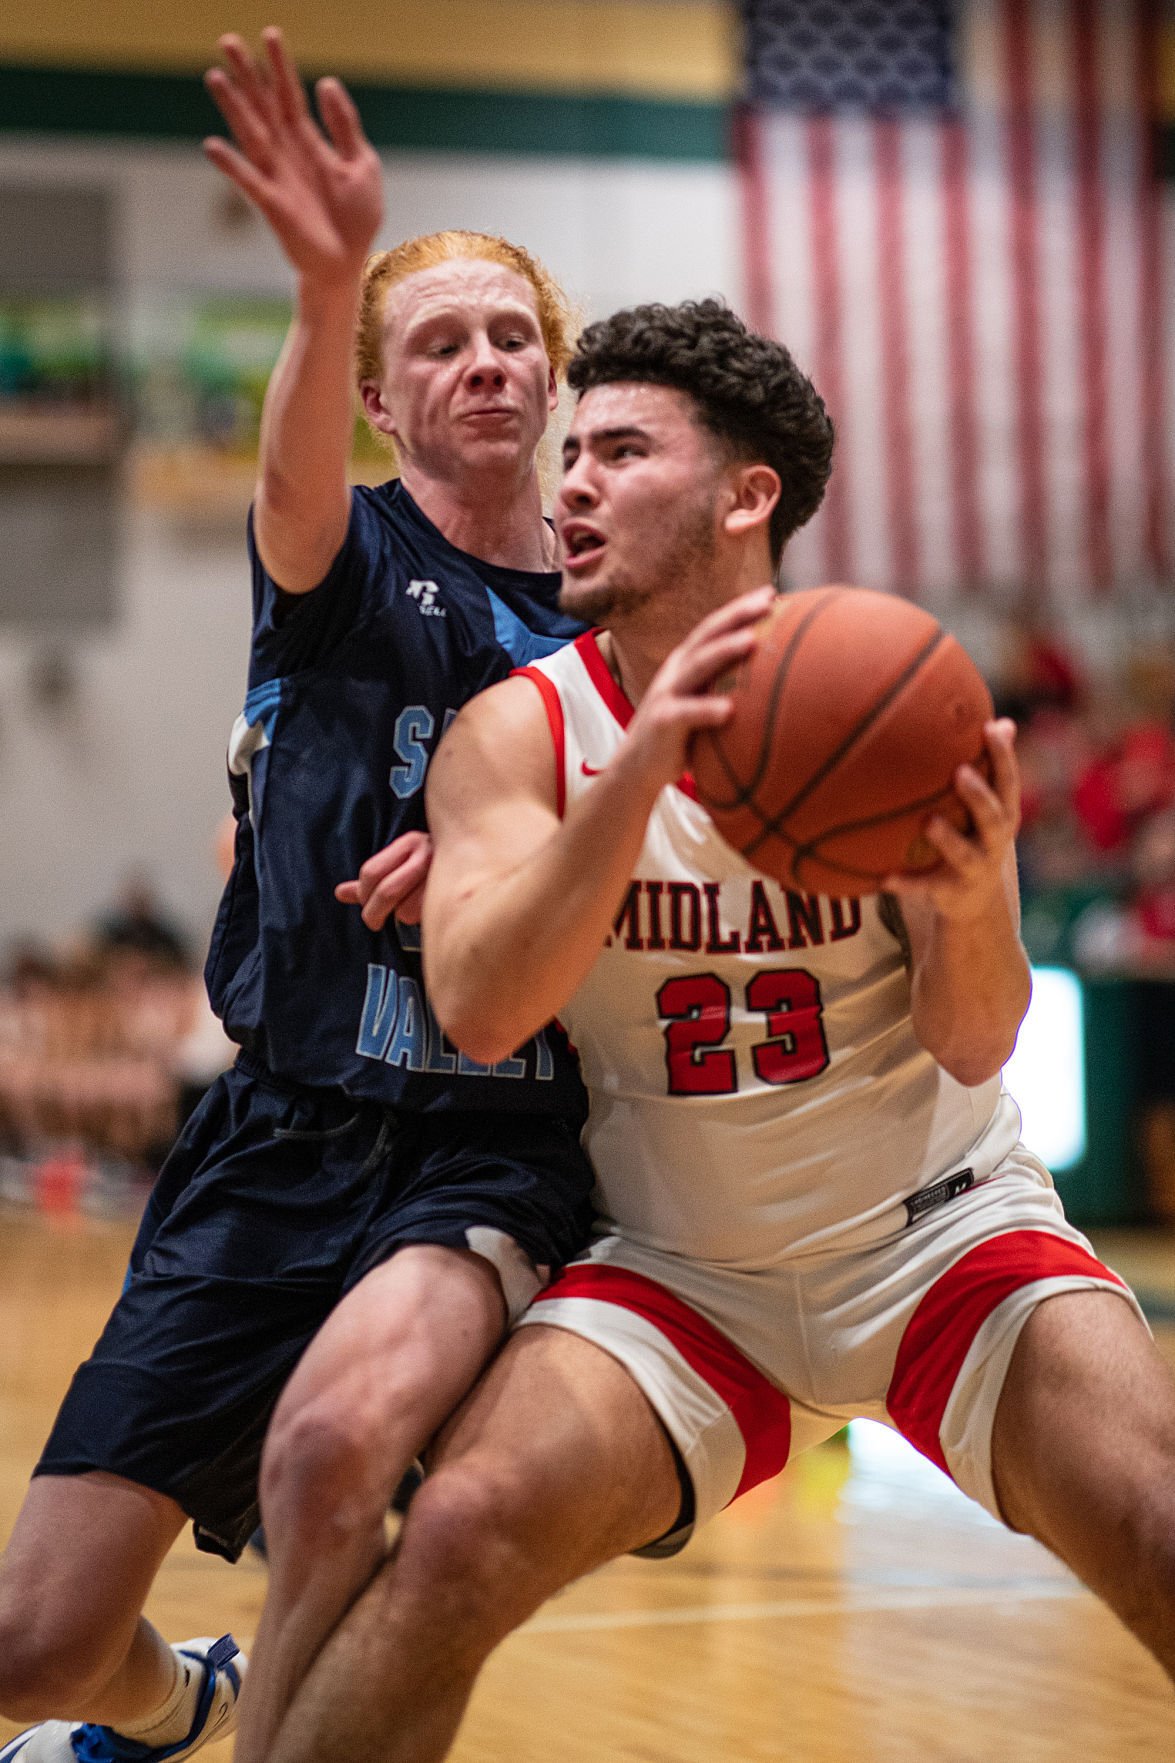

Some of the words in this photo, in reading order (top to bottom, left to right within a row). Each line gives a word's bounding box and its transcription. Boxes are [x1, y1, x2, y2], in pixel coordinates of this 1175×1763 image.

[603, 880, 862, 955] MIDLAND
[355, 963, 554, 1080] VAL
[655, 969, 830, 1096] 23
